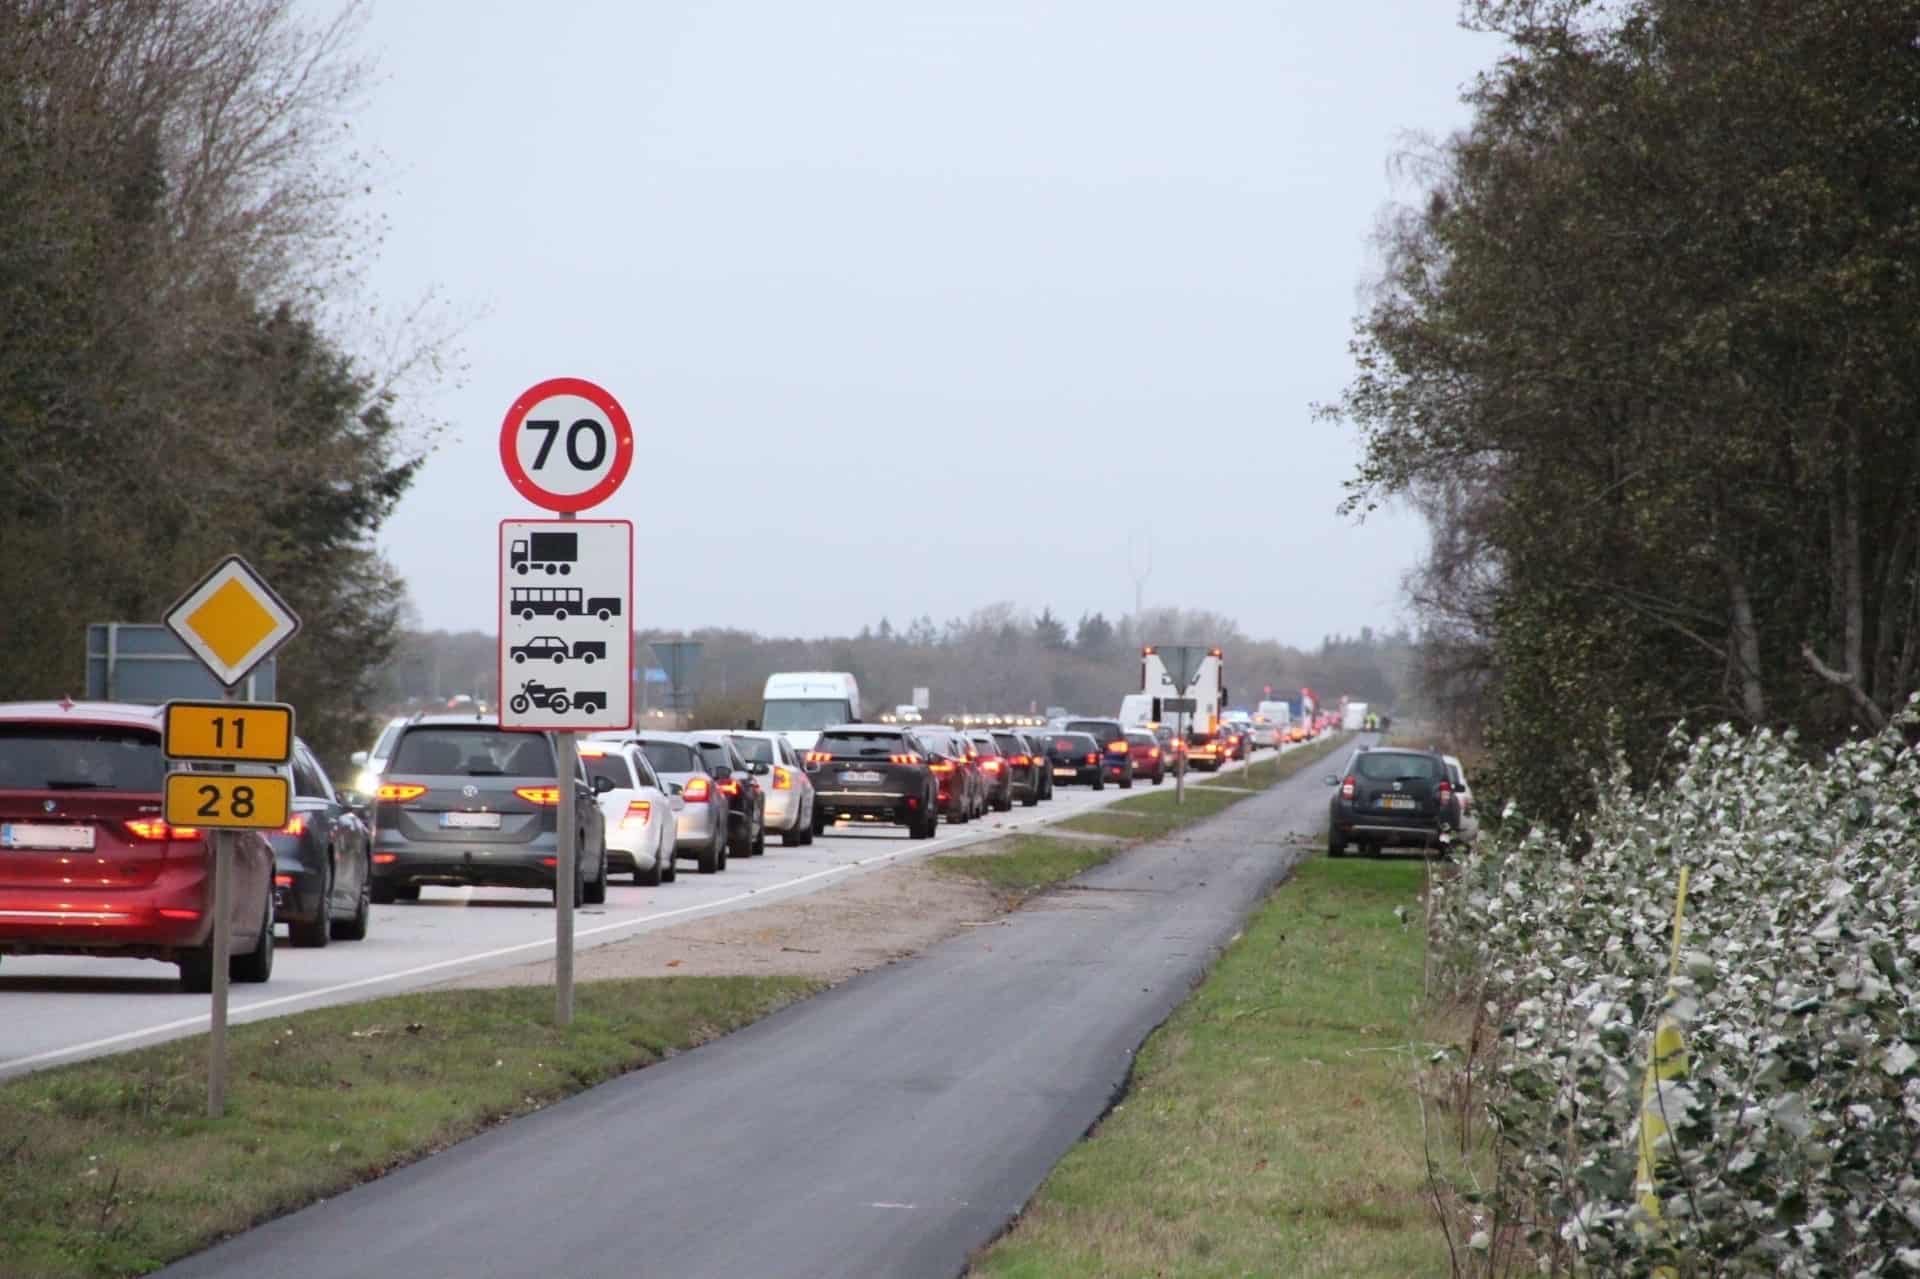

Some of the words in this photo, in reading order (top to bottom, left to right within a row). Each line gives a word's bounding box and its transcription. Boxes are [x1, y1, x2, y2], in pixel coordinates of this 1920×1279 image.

[526, 419, 607, 471] 70
[212, 717, 245, 749] 11
[197, 785, 255, 818] 28
